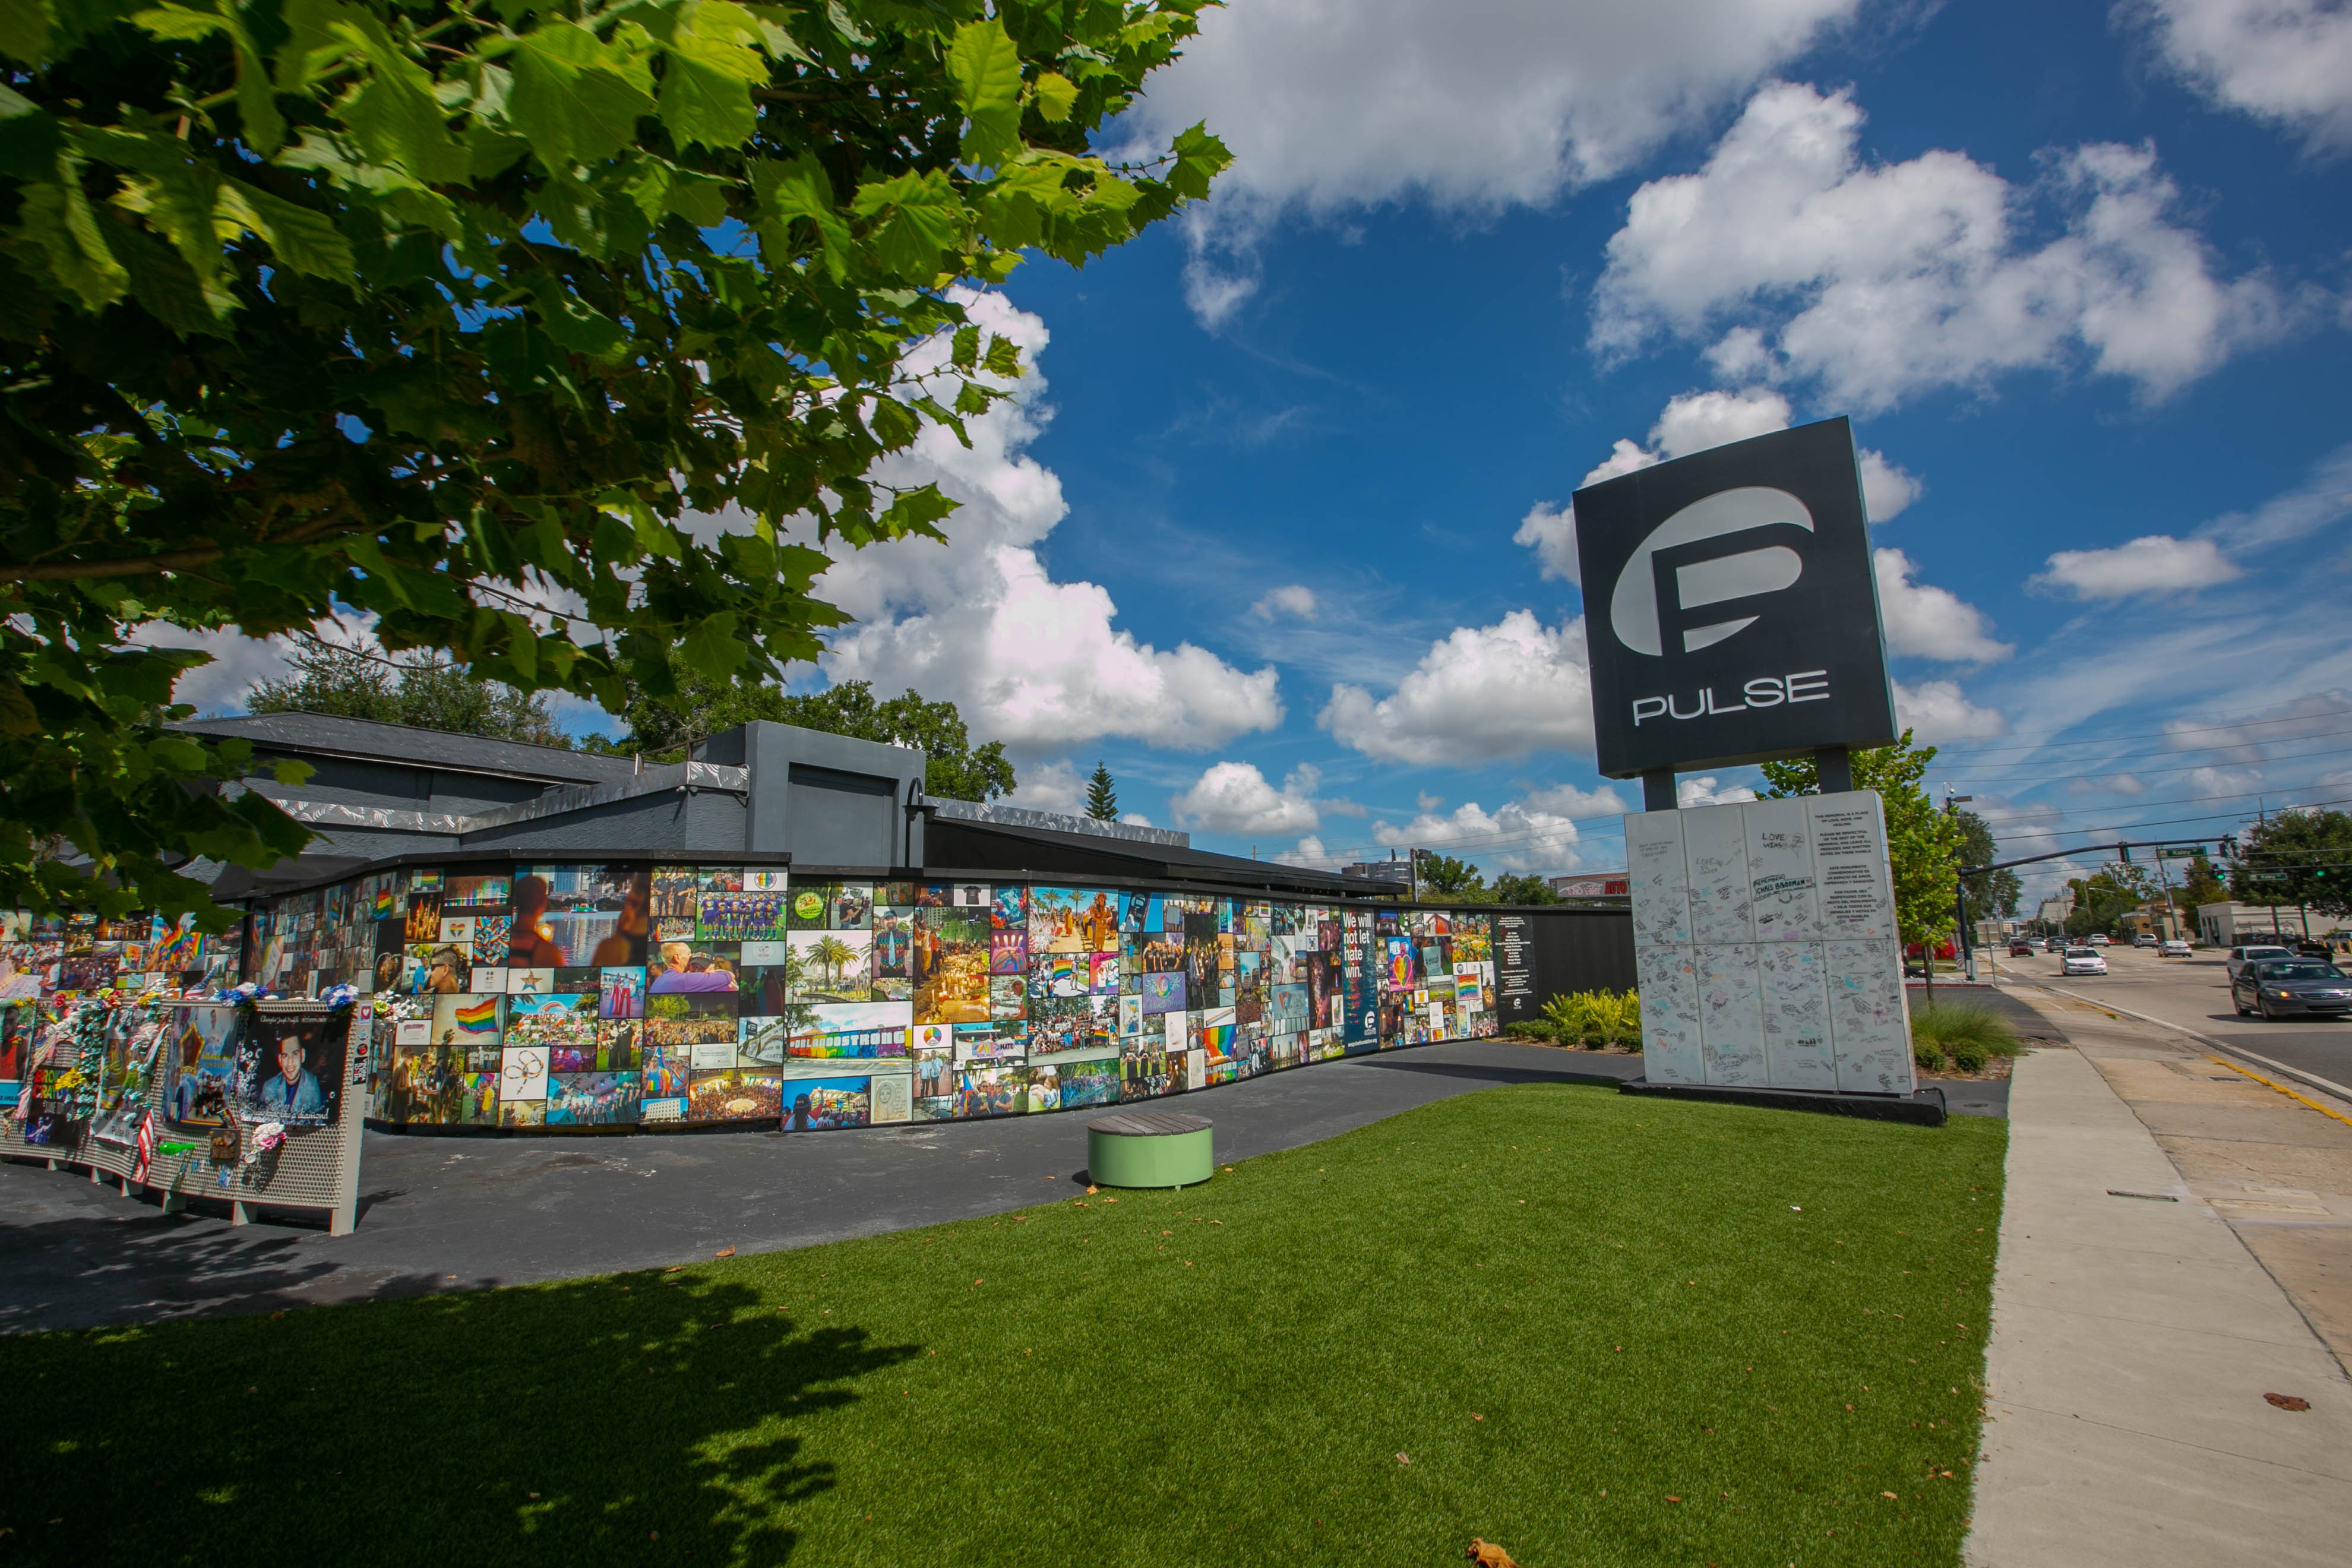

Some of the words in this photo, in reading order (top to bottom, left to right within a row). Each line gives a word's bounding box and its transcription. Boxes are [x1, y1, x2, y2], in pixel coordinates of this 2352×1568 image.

[1633, 669, 1830, 726] PULSE
[1762, 832, 1785, 840] LOVE
[1605, 881, 1627, 894] AUTO
[1754, 876, 1782, 886] REMEMBER
[1757, 884, 1773, 894] CHRIS
[1343, 912, 1357, 928] We
[1358, 913, 1371, 928] will
[1343, 930, 1358, 944] not
[1359, 929, 1370, 944] let
[1344, 946, 1363, 961] hate
[1345, 963, 1362, 978] win.
[972, 1042, 995, 1055] LOVE
[298, 1107, 329, 1120] diamond
[112, 1126, 124, 1137] Pulse
